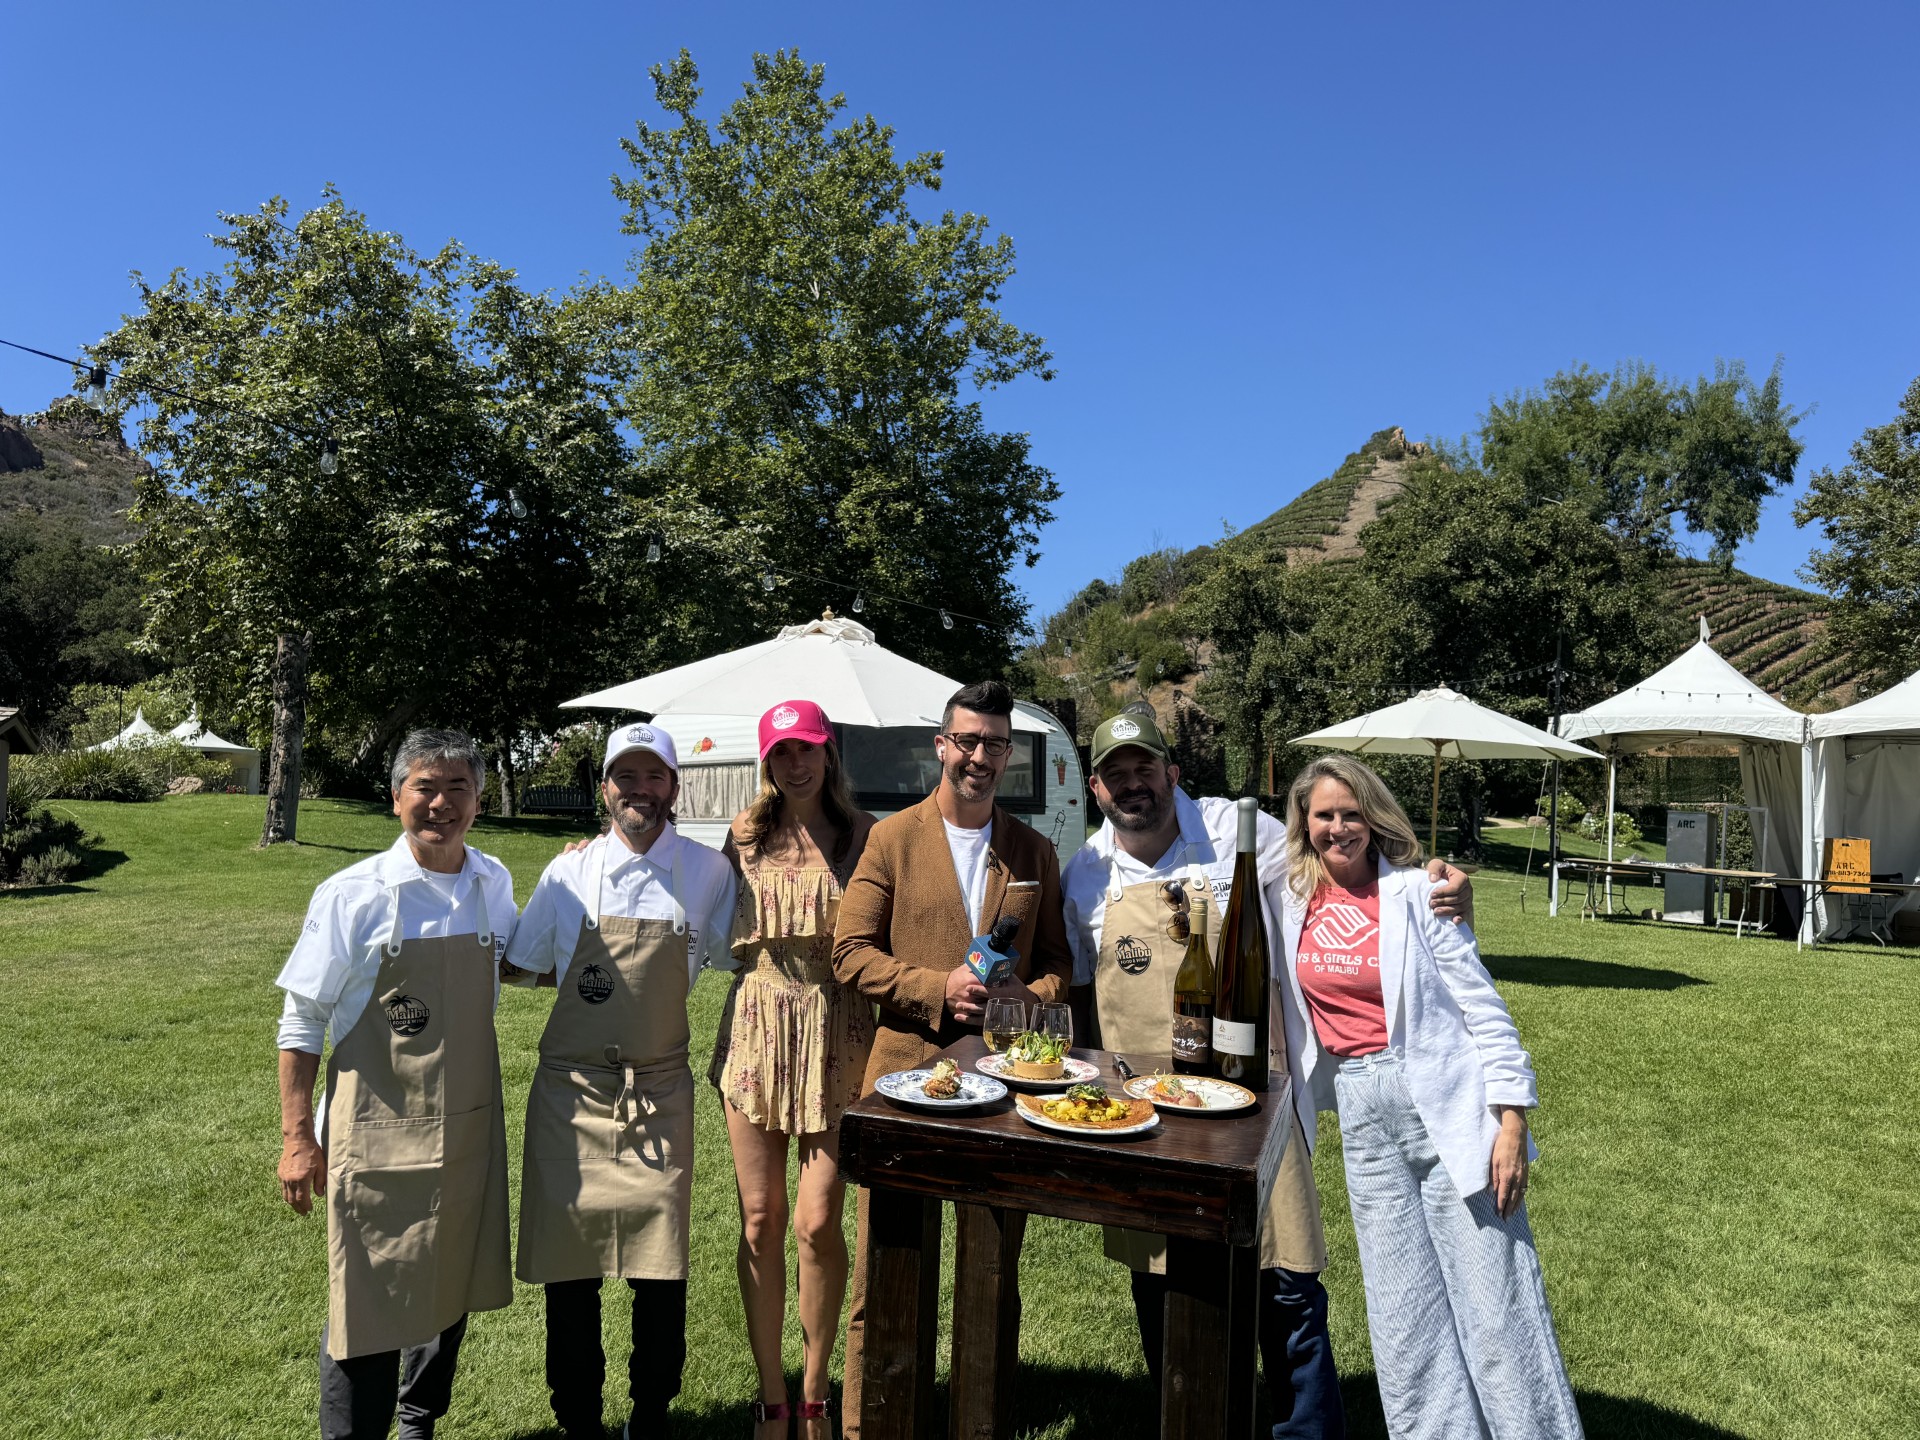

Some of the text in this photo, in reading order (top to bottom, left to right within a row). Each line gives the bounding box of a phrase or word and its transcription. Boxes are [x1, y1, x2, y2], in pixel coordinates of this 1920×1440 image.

[1677, 819, 1695, 829] ARC
[1836, 862, 1855, 870] ARC
[1115, 947, 1152, 960] Malibu
[1297, 953, 1309, 963] YS
[1311, 952, 1321, 963] &
[1323, 953, 1362, 966] GIRLS
[1314, 965, 1359, 975] OF MALIBU
[577, 975, 615, 990] Malibu
[387, 1007, 430, 1021] Malibu
